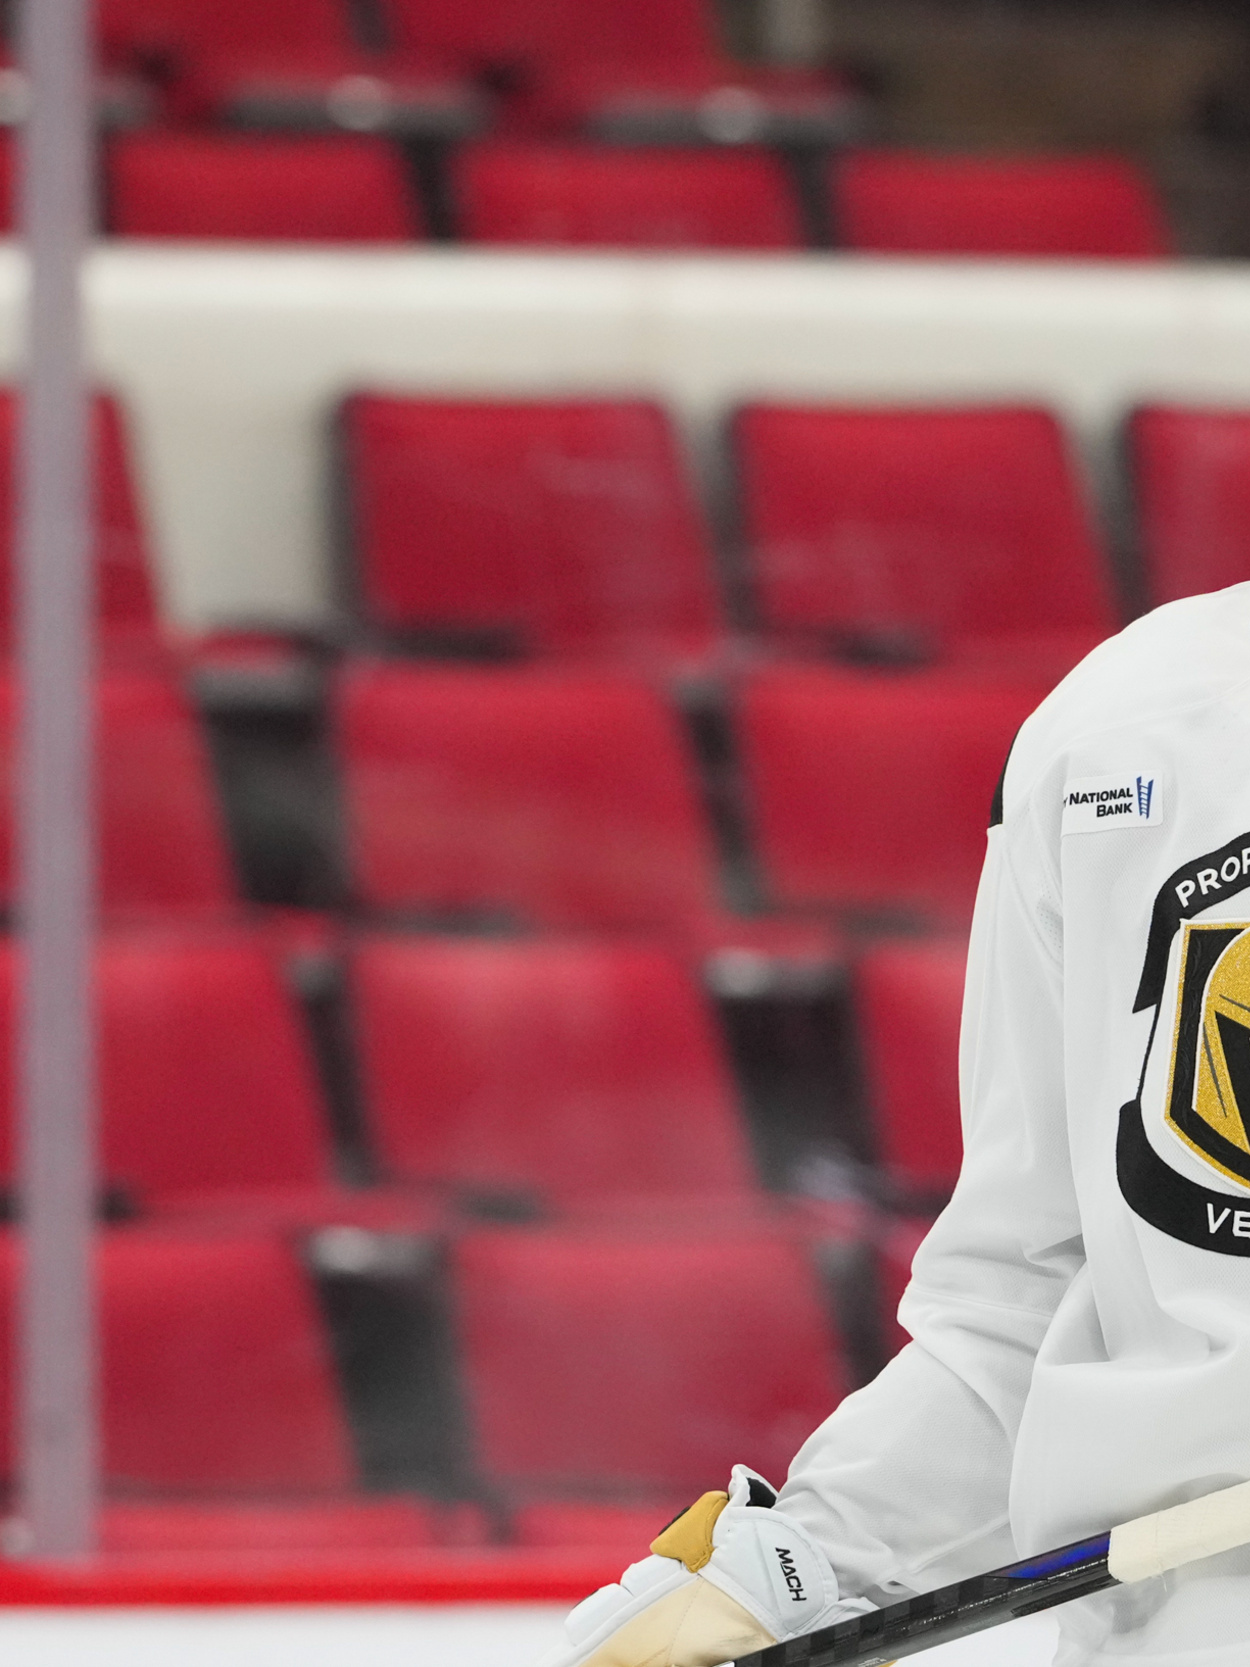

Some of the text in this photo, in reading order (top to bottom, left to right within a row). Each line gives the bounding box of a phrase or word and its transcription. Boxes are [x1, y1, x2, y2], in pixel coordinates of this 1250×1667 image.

[1068, 787, 1134, 806] NATIONAL
[1096, 802, 1133, 818] BANK
[775, 1546, 807, 1602] MACH
